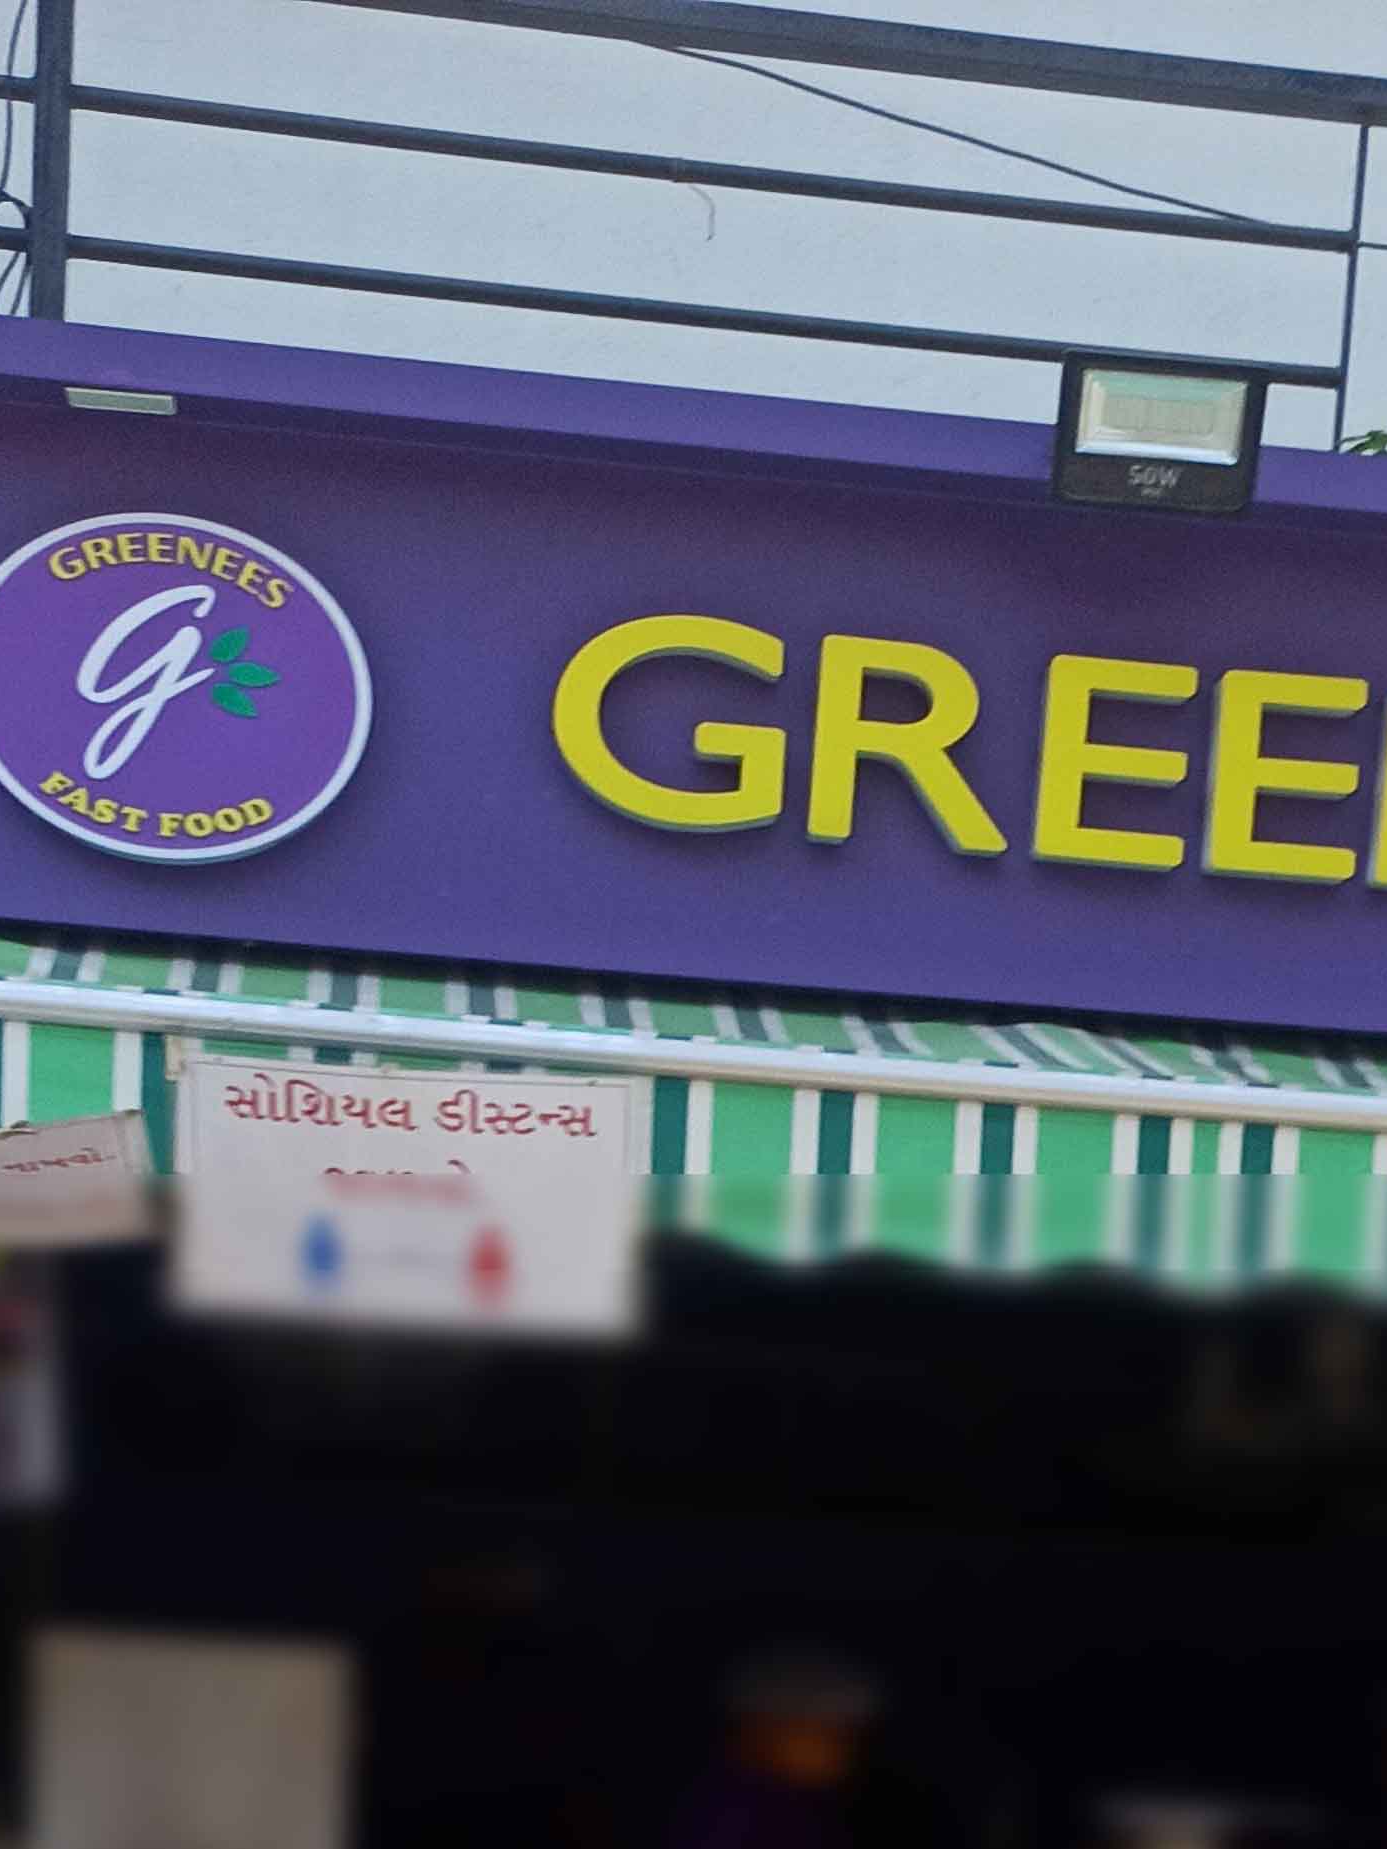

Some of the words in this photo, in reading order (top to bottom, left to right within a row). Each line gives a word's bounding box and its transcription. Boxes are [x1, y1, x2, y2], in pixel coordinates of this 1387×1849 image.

[47, 532, 294, 609] GREENEES
[39, 771, 148, 833] FAST
[159, 797, 274, 837] FOOD
[224, 1072, 419, 1132] સોશિયલ
